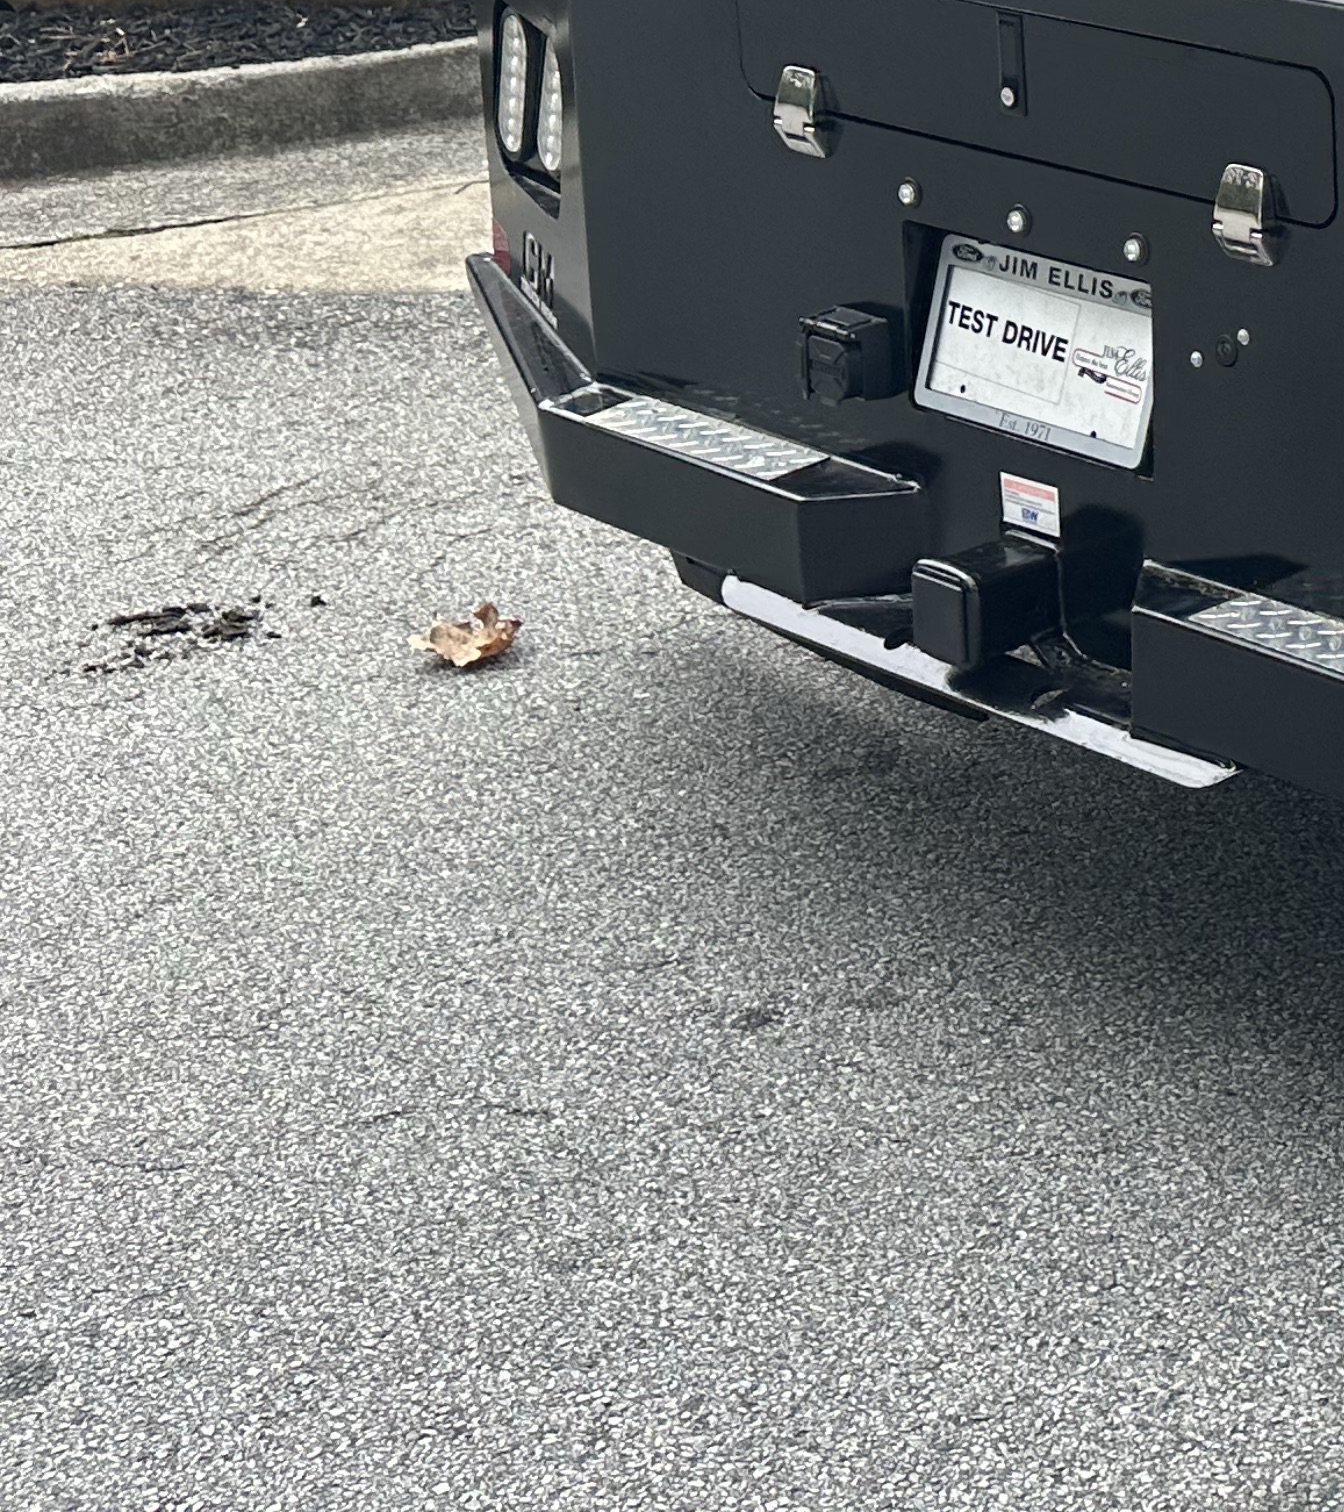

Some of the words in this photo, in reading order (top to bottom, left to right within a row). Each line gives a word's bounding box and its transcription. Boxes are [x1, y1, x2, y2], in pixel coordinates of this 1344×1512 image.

[999, 255, 1038, 280] JIM
[1047, 268, 1114, 299] ELLIS
[948, 301, 998, 338] TEST
[1002, 320, 1069, 362] DRIVE
[999, 413, 1021, 431] Est.
[1024, 419, 1052, 440] 1971
